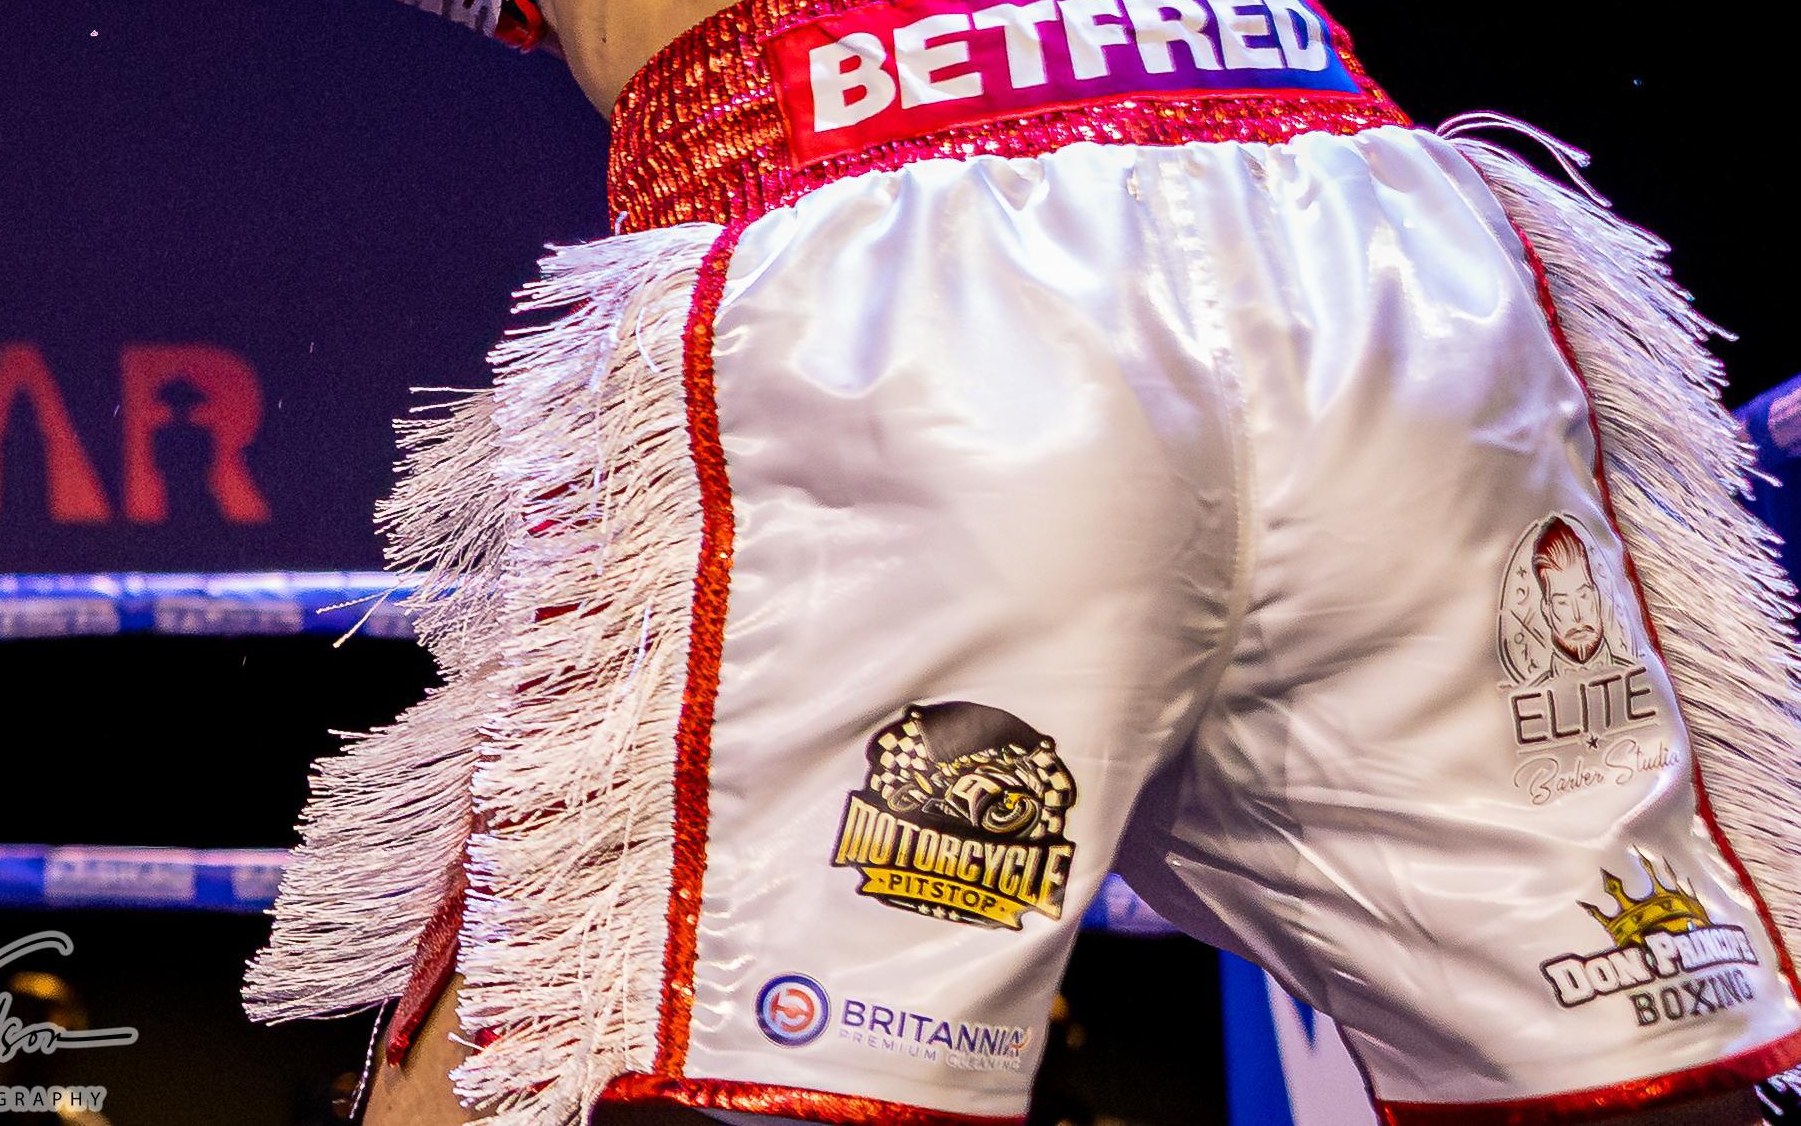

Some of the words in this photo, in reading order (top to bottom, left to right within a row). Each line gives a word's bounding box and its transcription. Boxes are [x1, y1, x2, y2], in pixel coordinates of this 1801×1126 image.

[1511, 666, 1656, 745] ELITE
[1513, 757, 1605, 805] Barber
[1604, 739, 1680, 785] Studio
[835, 794, 1075, 920] MOTORCYCLE
[887, 873, 998, 912] PITSTOP
[1628, 967, 1755, 1027] BOXING
[837, 1028, 937, 1062] PREMIUM
[945, 1052, 1021, 1071] CLEANNG
[840, 998, 1024, 1058] BRITANNIA
